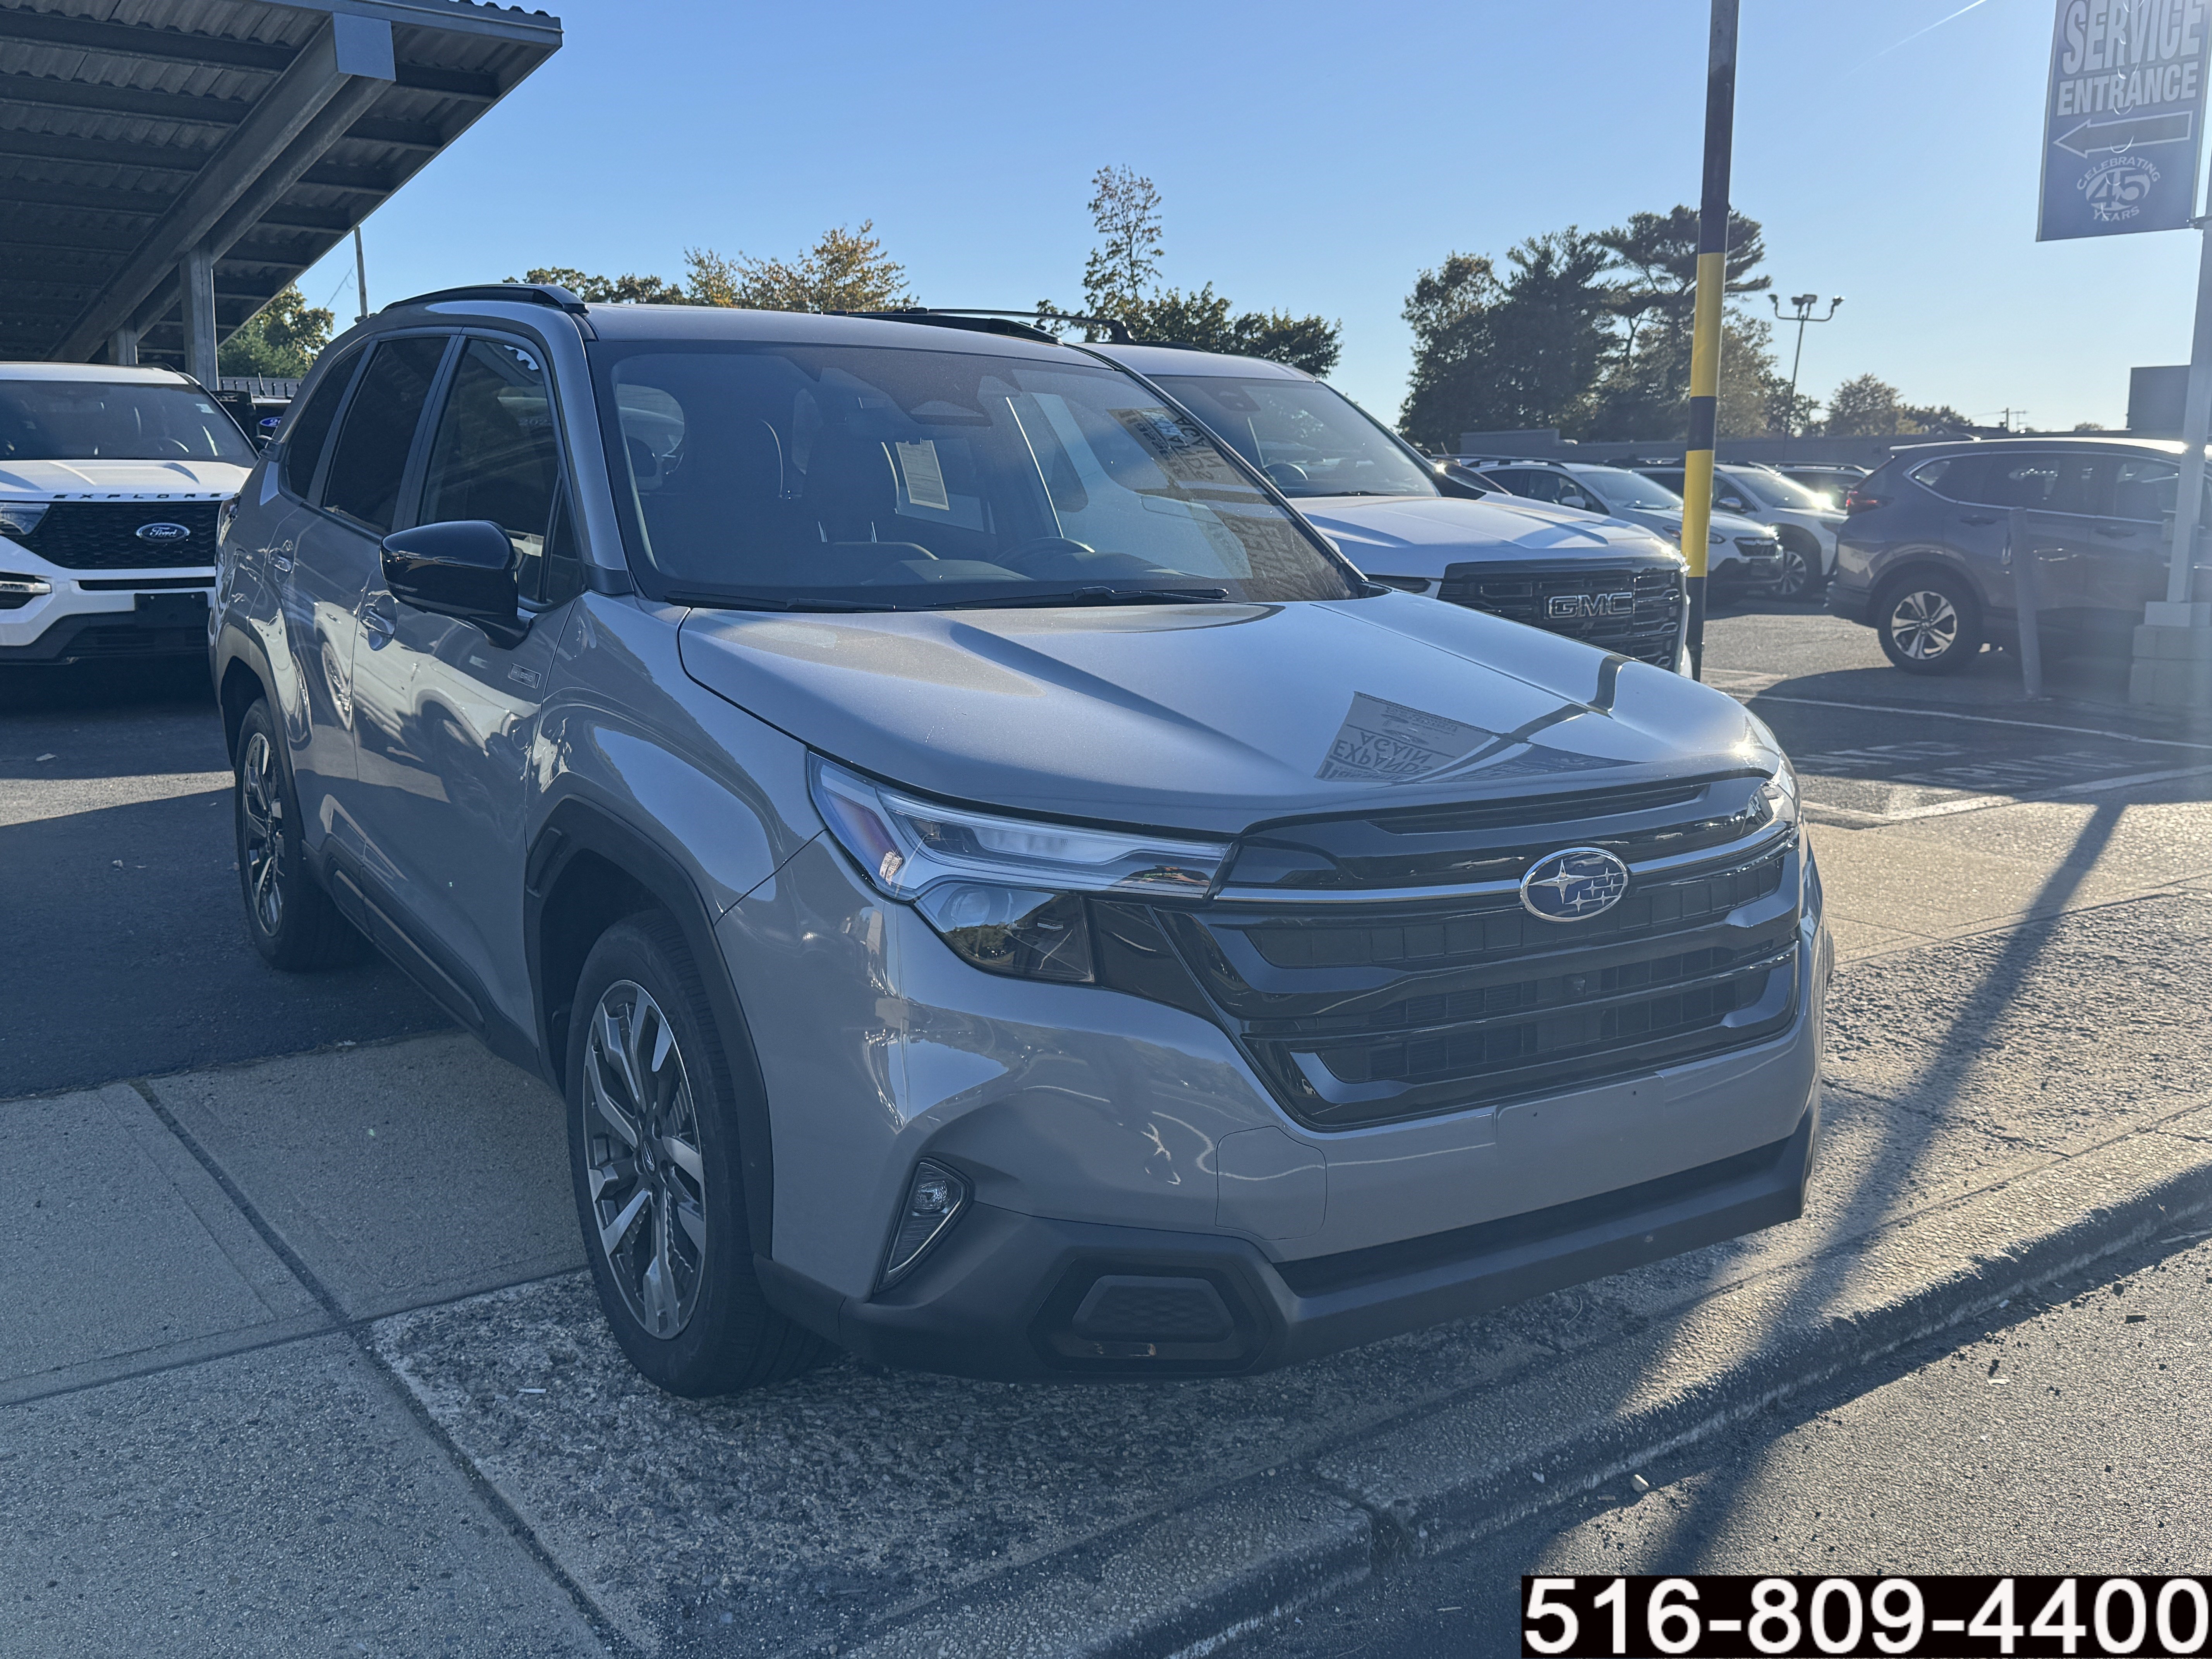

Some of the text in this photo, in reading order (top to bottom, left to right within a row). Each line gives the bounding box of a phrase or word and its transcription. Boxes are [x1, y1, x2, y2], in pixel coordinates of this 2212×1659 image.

[2063, 0, 2202, 74] SERVICE
[2057, 62, 2198, 116] ENTRANCE
[2076, 156, 2160, 190] CELEBRATING
[2092, 169, 2145, 206] 45
[2094, 206, 2140, 221] YEARS
[149, 527, 177, 536] Ford
[1549, 592, 1632, 618] GMC
